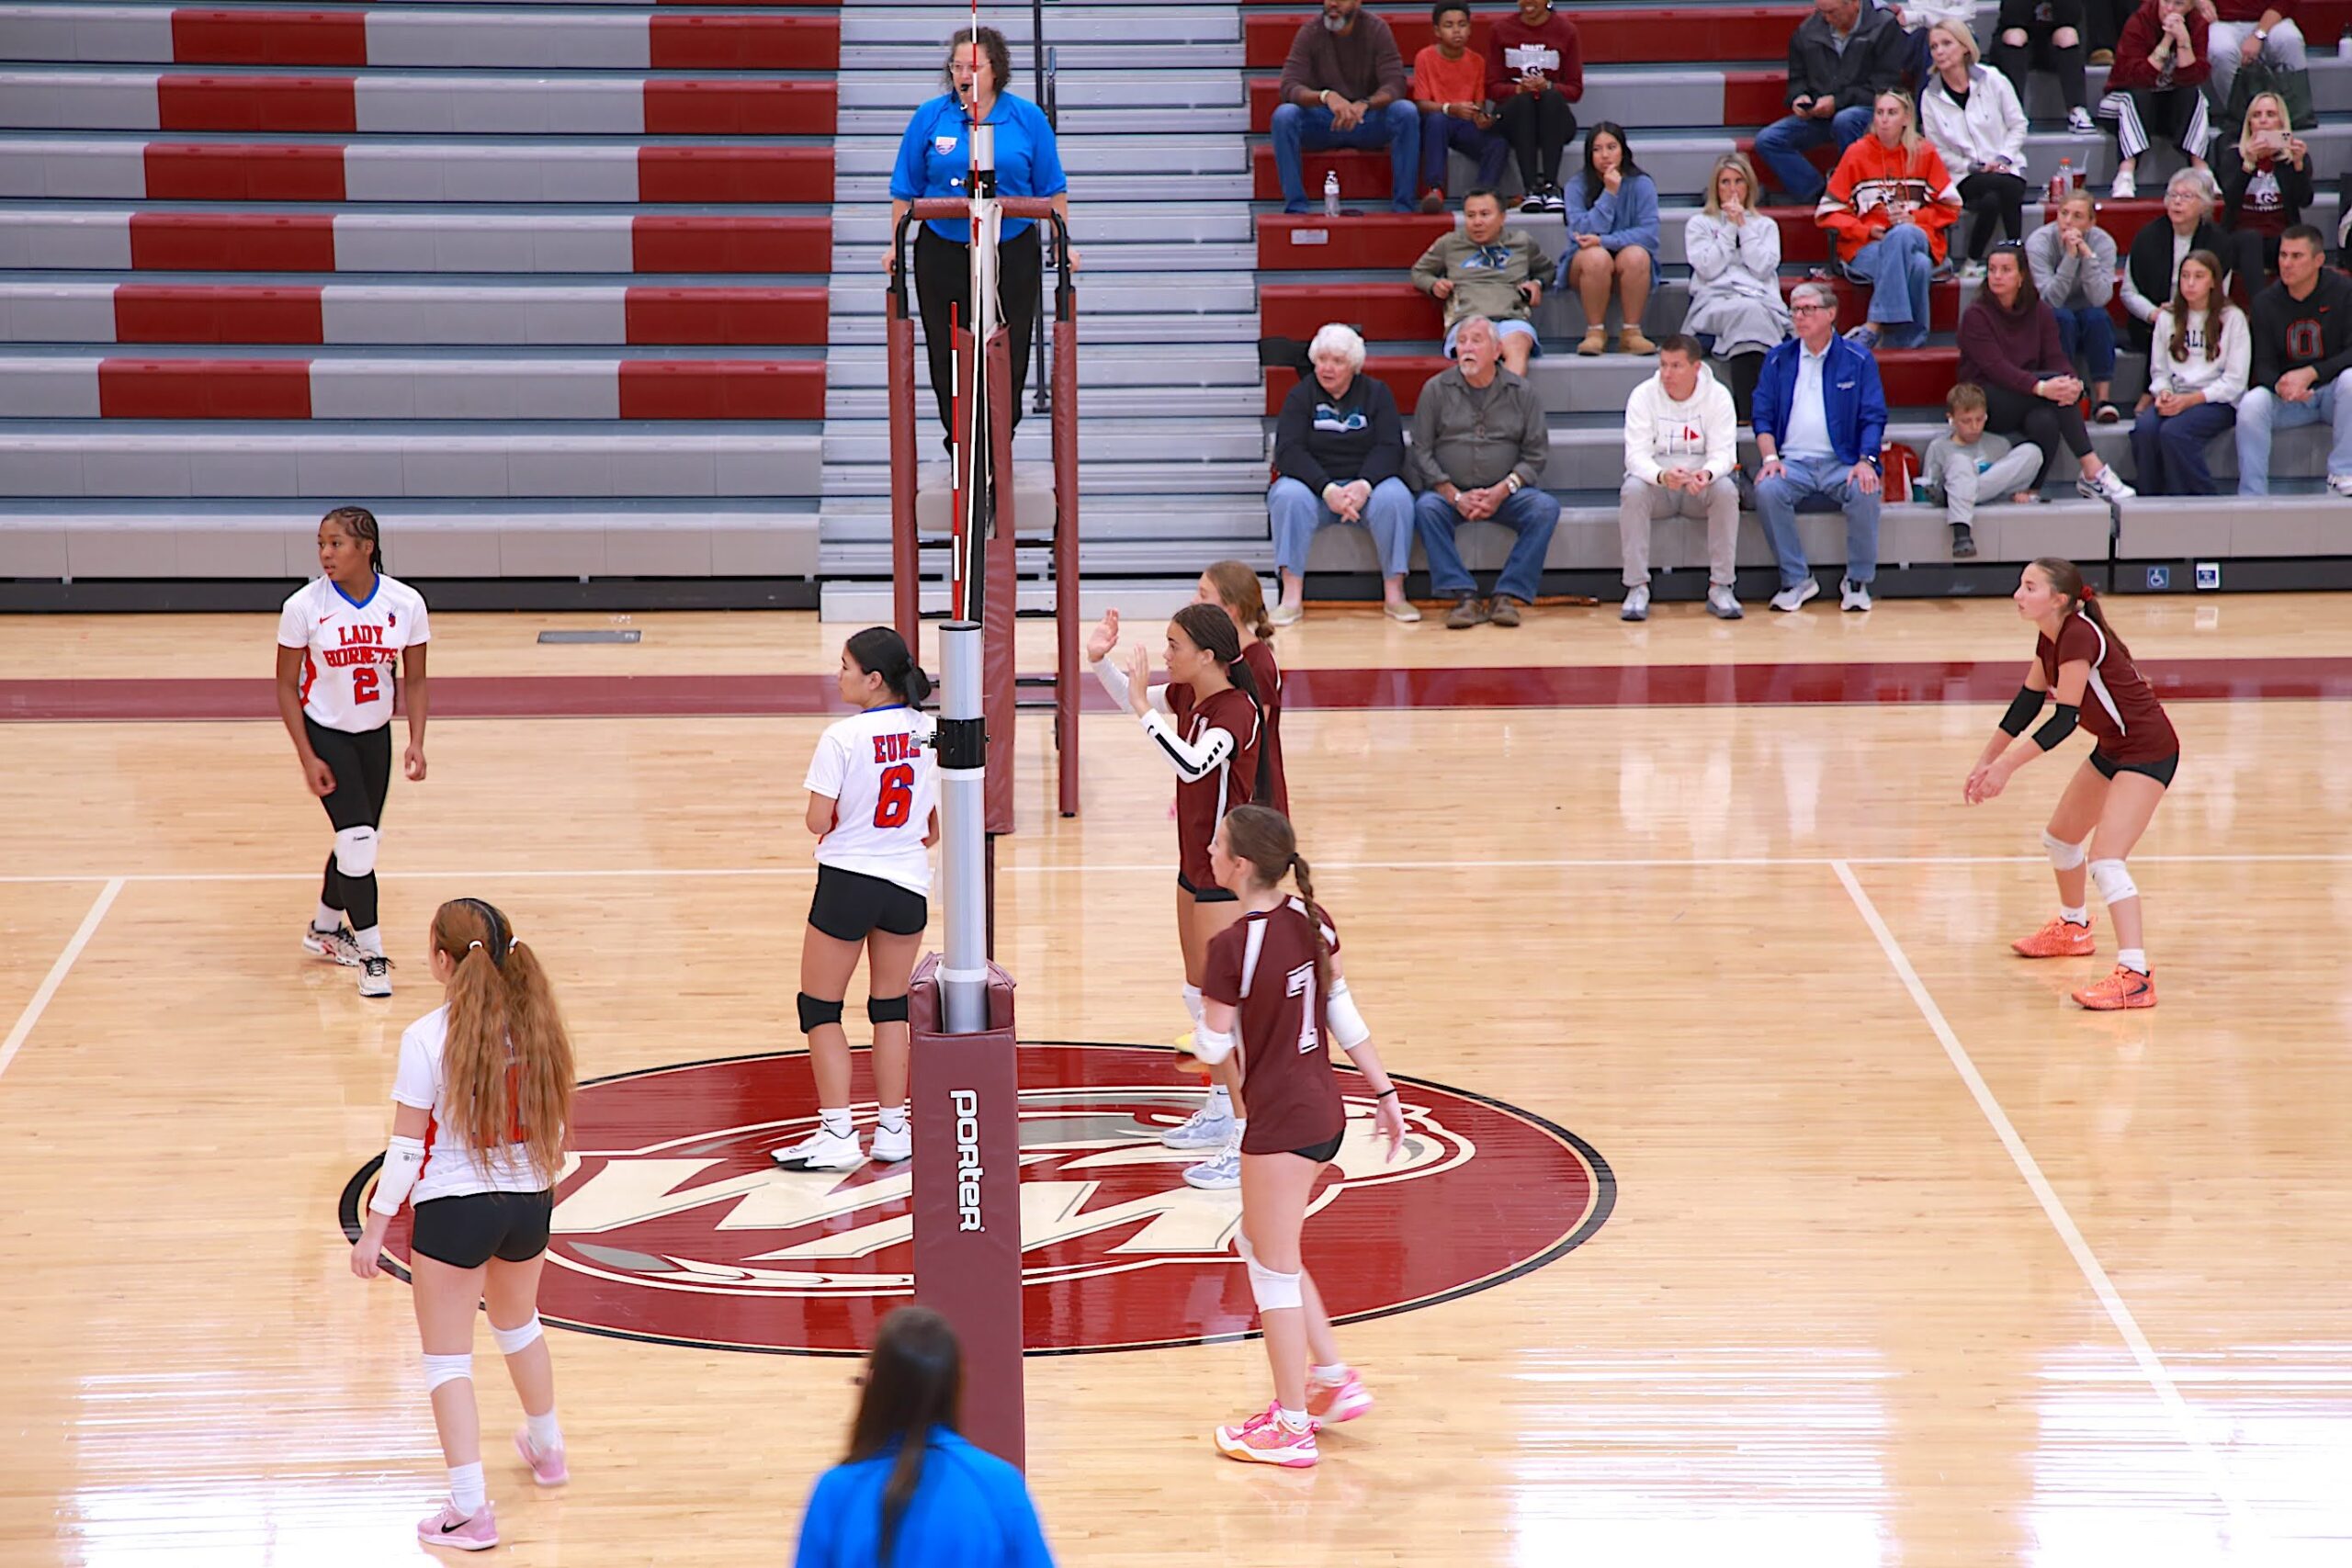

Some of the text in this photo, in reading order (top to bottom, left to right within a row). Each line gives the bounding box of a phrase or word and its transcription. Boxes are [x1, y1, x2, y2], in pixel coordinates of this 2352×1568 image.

[338, 625, 383, 646] LADY
[322, 646, 399, 668] HORNETS
[353, 667, 380, 705] 2
[873, 762, 915, 829] 6
[1285, 960, 1319, 1055] 7
